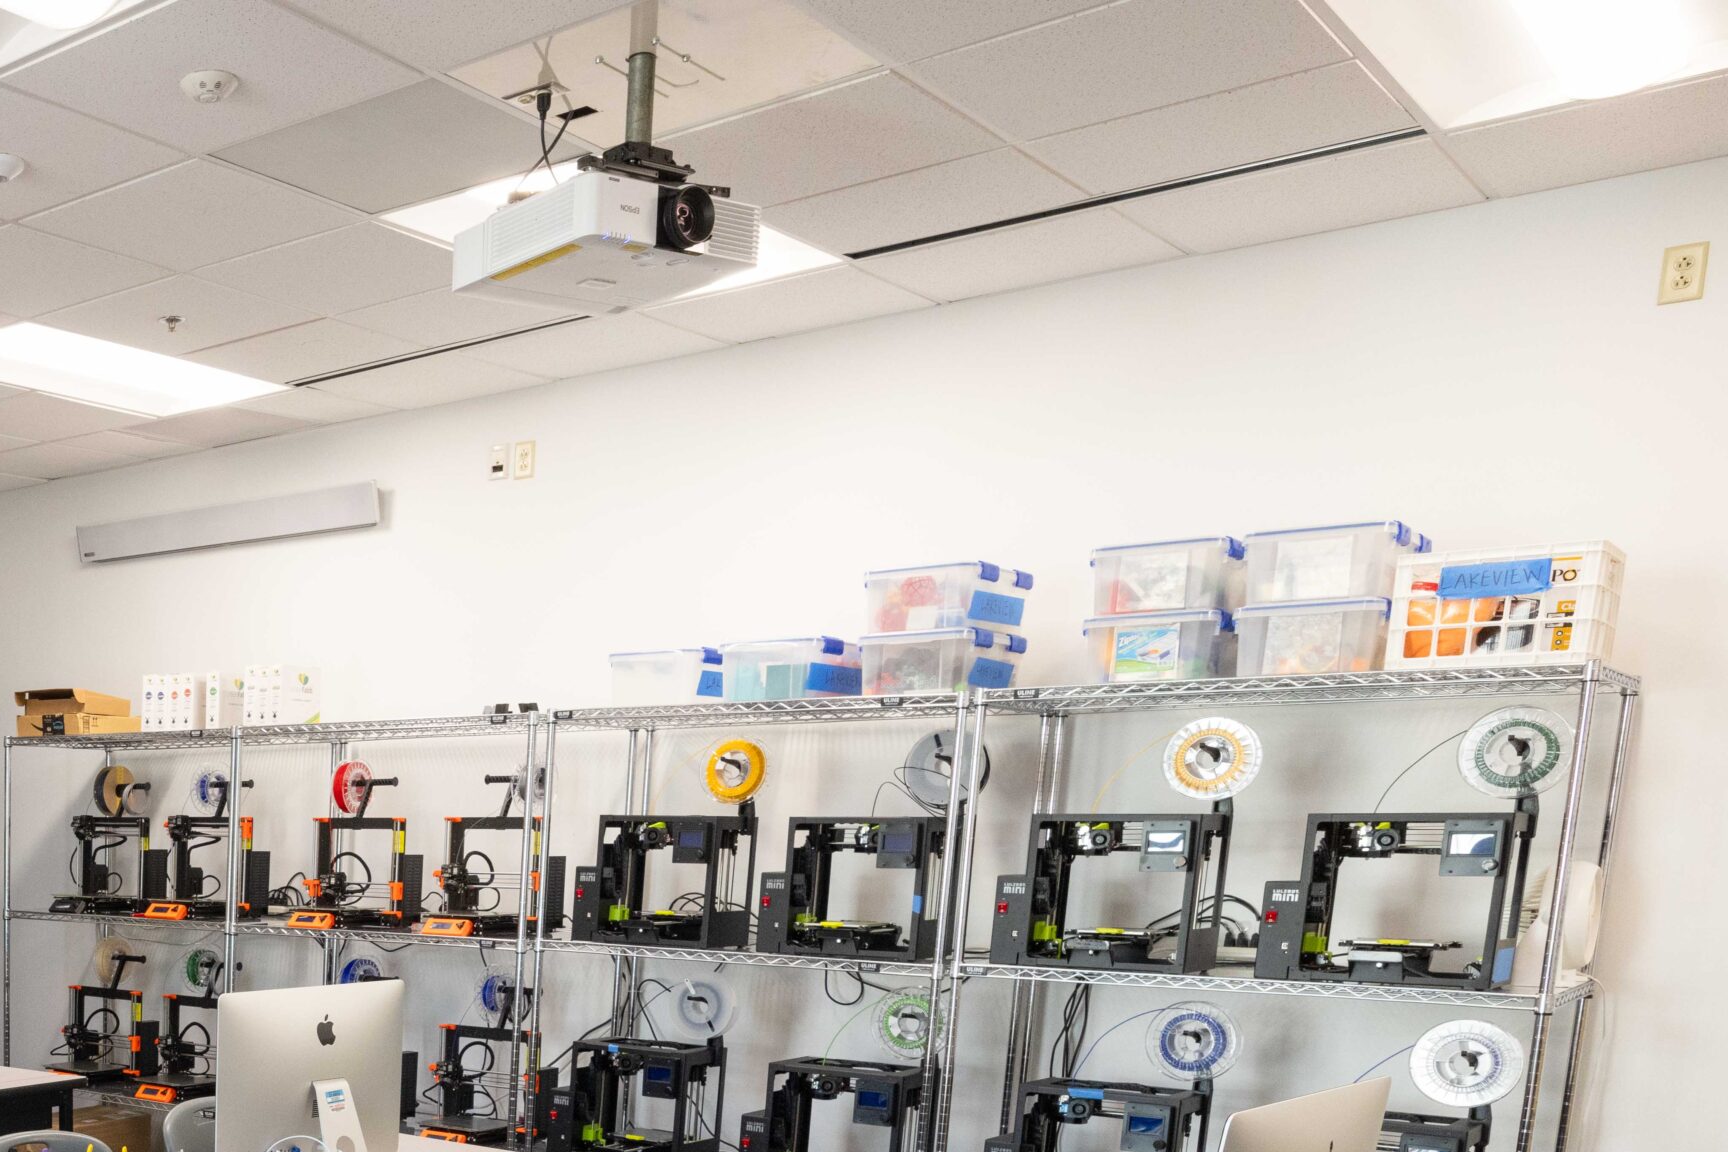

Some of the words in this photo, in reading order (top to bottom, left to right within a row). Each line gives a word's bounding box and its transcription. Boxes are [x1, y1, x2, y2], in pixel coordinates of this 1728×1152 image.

[1440, 566, 1545, 590] LAKEVIEW
[1003, 886, 1025, 894] mini
[1272, 893, 1299, 902] mini
[746, 1125, 764, 1133] mini
